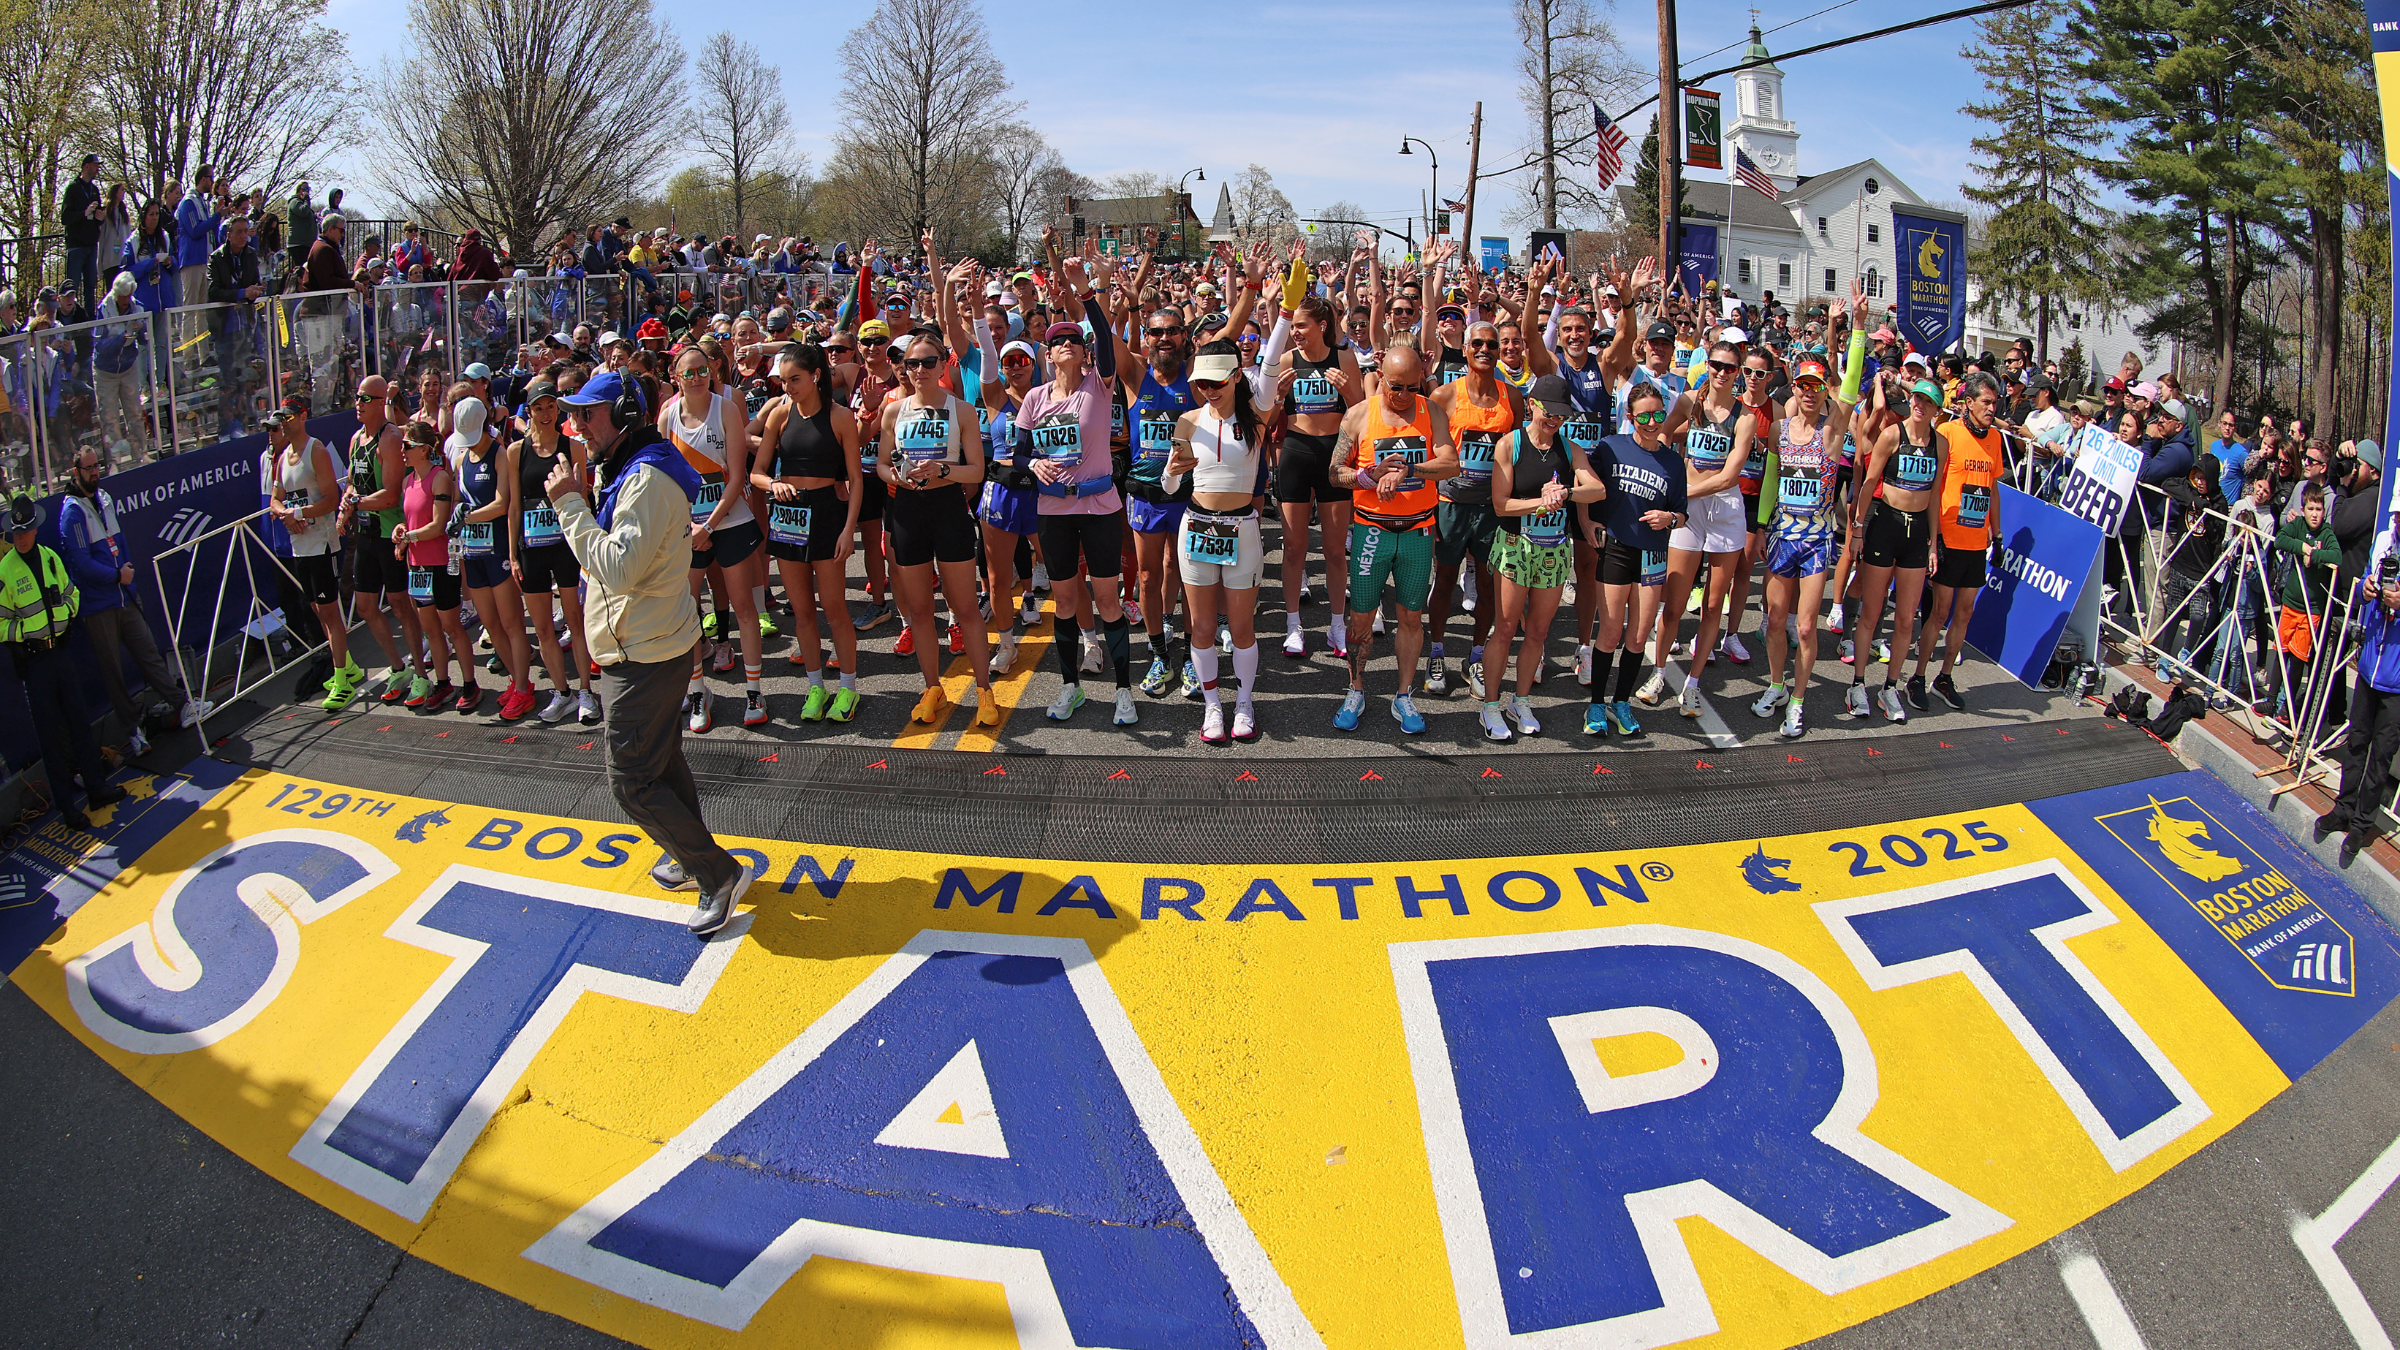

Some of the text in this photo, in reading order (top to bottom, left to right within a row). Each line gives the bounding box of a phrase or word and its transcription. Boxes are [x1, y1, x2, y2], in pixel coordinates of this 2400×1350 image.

[2373, 21, 2400, 32] BANK
[1686, 94, 1719, 109] HOPKINTON
[1691, 252, 1715, 260] AMERICA
[1911, 280, 1949, 296] BOSTON
[1911, 293, 1949, 306] MARATHON
[1296, 379, 1334, 396] 17501
[1584, 381, 1603, 390] BOSTON
[902, 421, 944, 440] 17445
[1035, 427, 1077, 448] 17926
[1142, 423, 1176, 441] 1758
[1563, 423, 1599, 442] 17508
[716, 441, 725, 450] 25
[1691, 432, 1727, 453] 17925
[2086, 428, 2141, 474] 26.2 MILES
[1464, 443, 1495, 462] 1772
[1780, 455, 1822, 465] SOUTHRUN
[1902, 457, 1933, 475] 17191
[1963, 459, 1992, 474] GERARDO
[2092, 457, 2117, 486] UNTIL
[116, 459, 251, 516] ANK OF AMERICA
[1612, 463, 1668, 497] ALTADENA
[1618, 478, 1657, 501] STRONG
[1783, 478, 1818, 497] 18074
[1963, 495, 1990, 513] 17036
[2061, 468, 2123, 536] BEER
[465, 524, 491, 539] 7967
[1190, 534, 1235, 557] 17534
[1358, 526, 1381, 576] MÉXICO
[16, 575, 30, 588] STATE
[410, 573, 433, 589] 18067
[1999, 549, 2070, 602] RATHON
[16, 582, 34, 596] POLICE
[39, 820, 105, 856] BOSTON
[265, 783, 396, 821] 129TH
[465, 816, 855, 899] BOSON
[1828, 821, 2009, 877] 2025
[23, 836, 83, 869] MARATHON
[31, 864, 61, 882] AMERICA
[2196, 871, 2291, 923] BOSTON
[2222, 890, 2309, 942] MARATHON
[2246, 911, 2325, 958] BANK OF AMERICA
[68, 828, 2210, 1350] START
